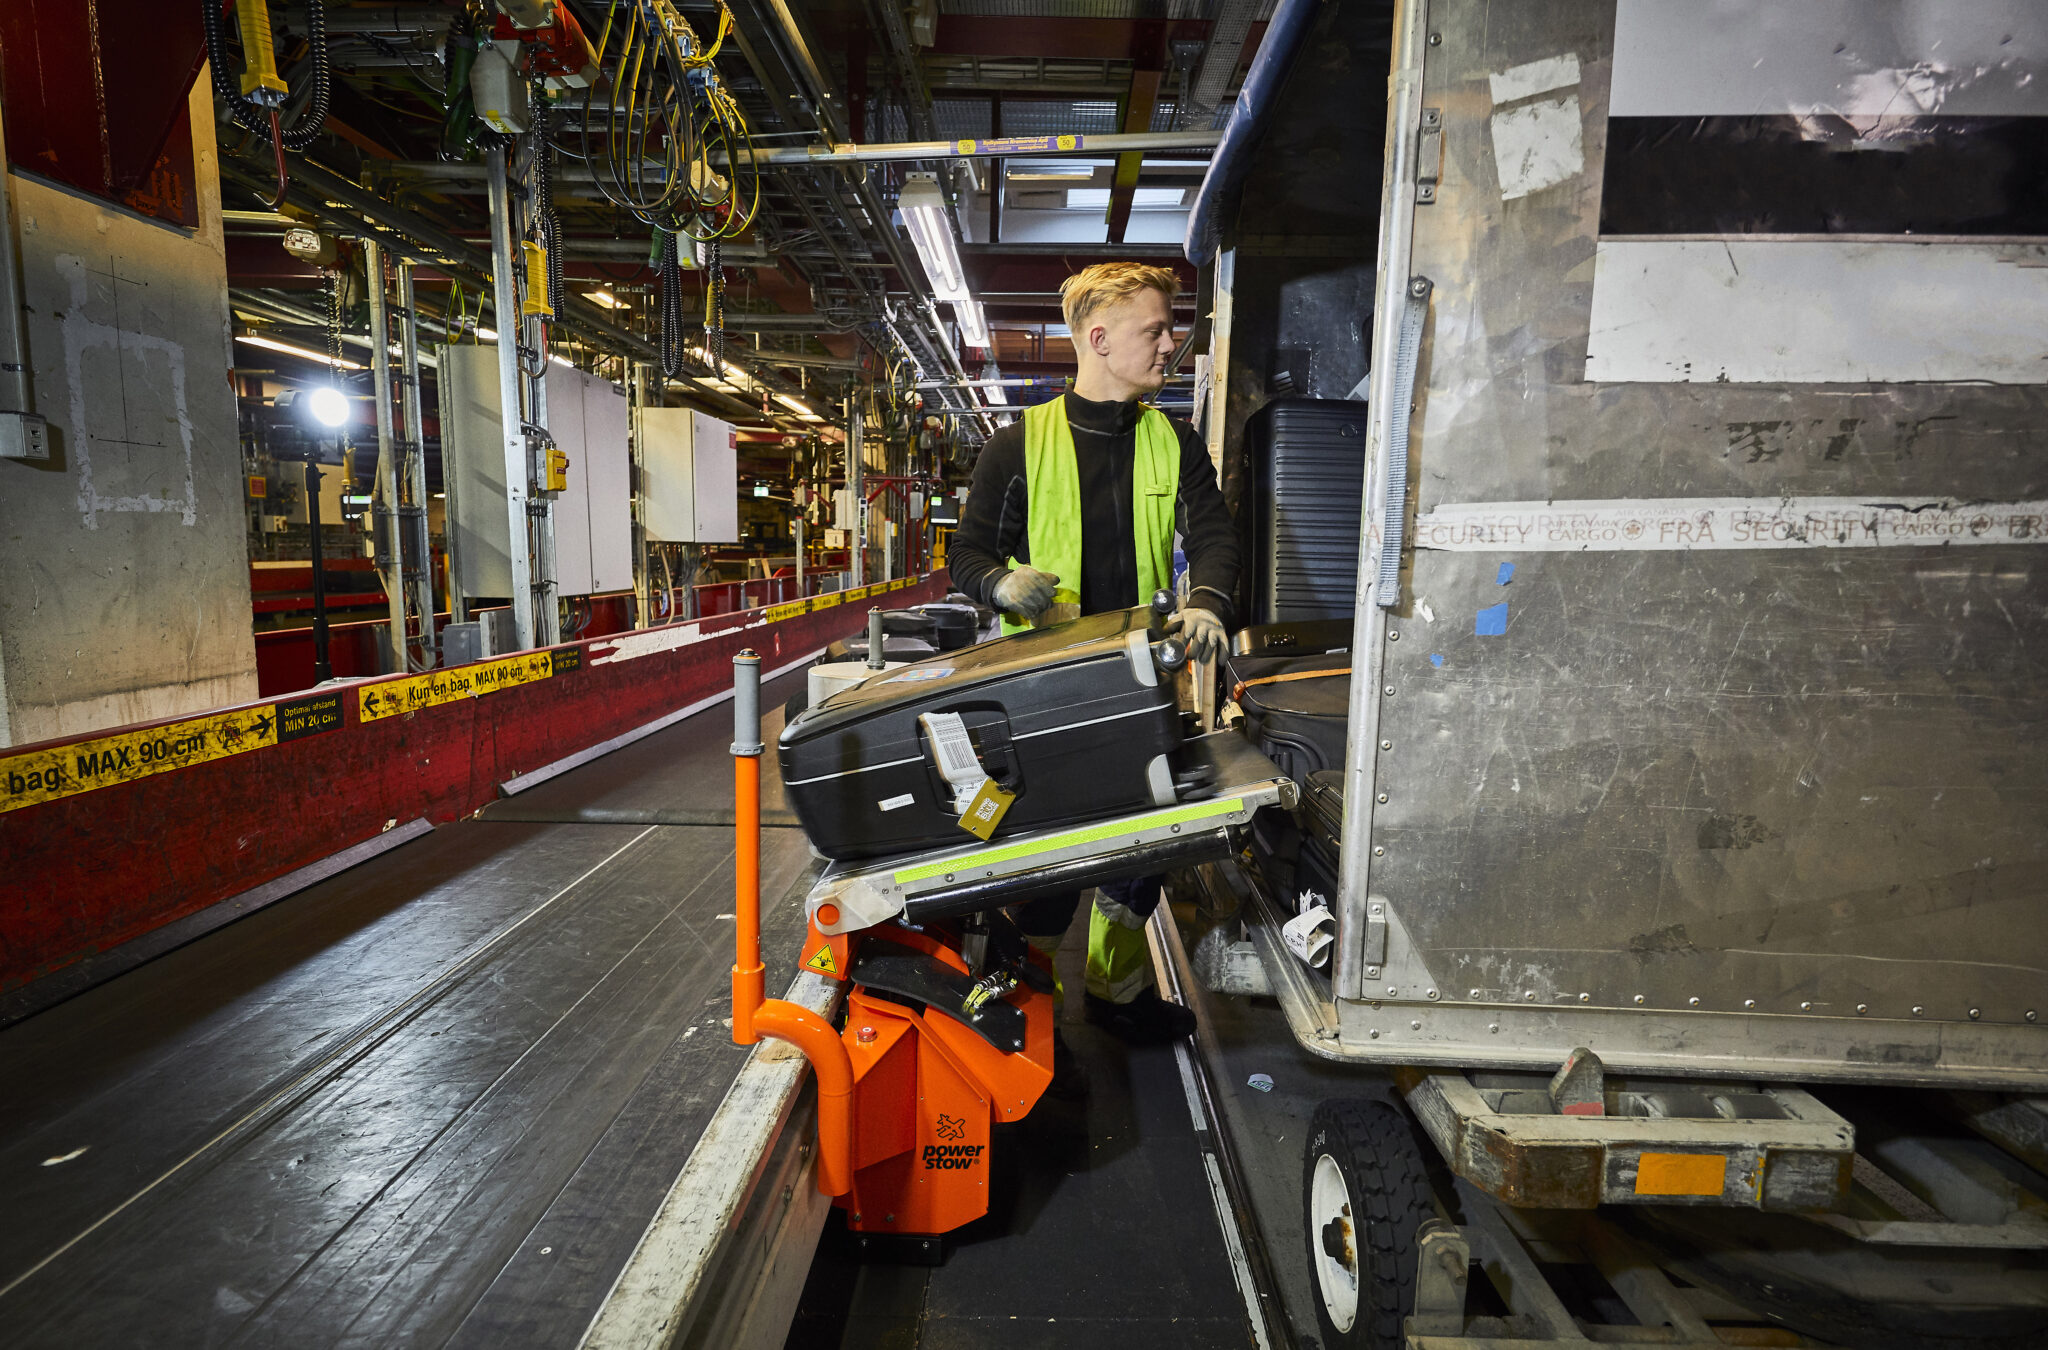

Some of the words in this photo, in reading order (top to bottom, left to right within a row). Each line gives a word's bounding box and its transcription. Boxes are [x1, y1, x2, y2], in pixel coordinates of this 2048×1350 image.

[1548, 528, 1619, 543] CARGO
[1660, 521, 1718, 545] FRA
[1734, 519, 1880, 543] SECURITY
[1893, 523, 1967, 538] CARGO
[408, 684, 431, 703] Kun
[433, 680, 448, 697] en
[450, 676, 473, 692] bag.
[475, 669, 495, 687] MAX
[509, 664, 523, 678] cm
[312, 698, 337, 713] afstand
[284, 717, 306, 734] MIN
[307, 714, 321, 727] 20
[322, 711, 338, 724] cm
[8, 769, 68, 796] bag.
[76, 745, 133, 780] MAX
[139, 737, 168, 765] 90
[174, 733, 206, 756] cm
[922, 1145, 985, 1161] power
[925, 1157, 974, 1170] stow
